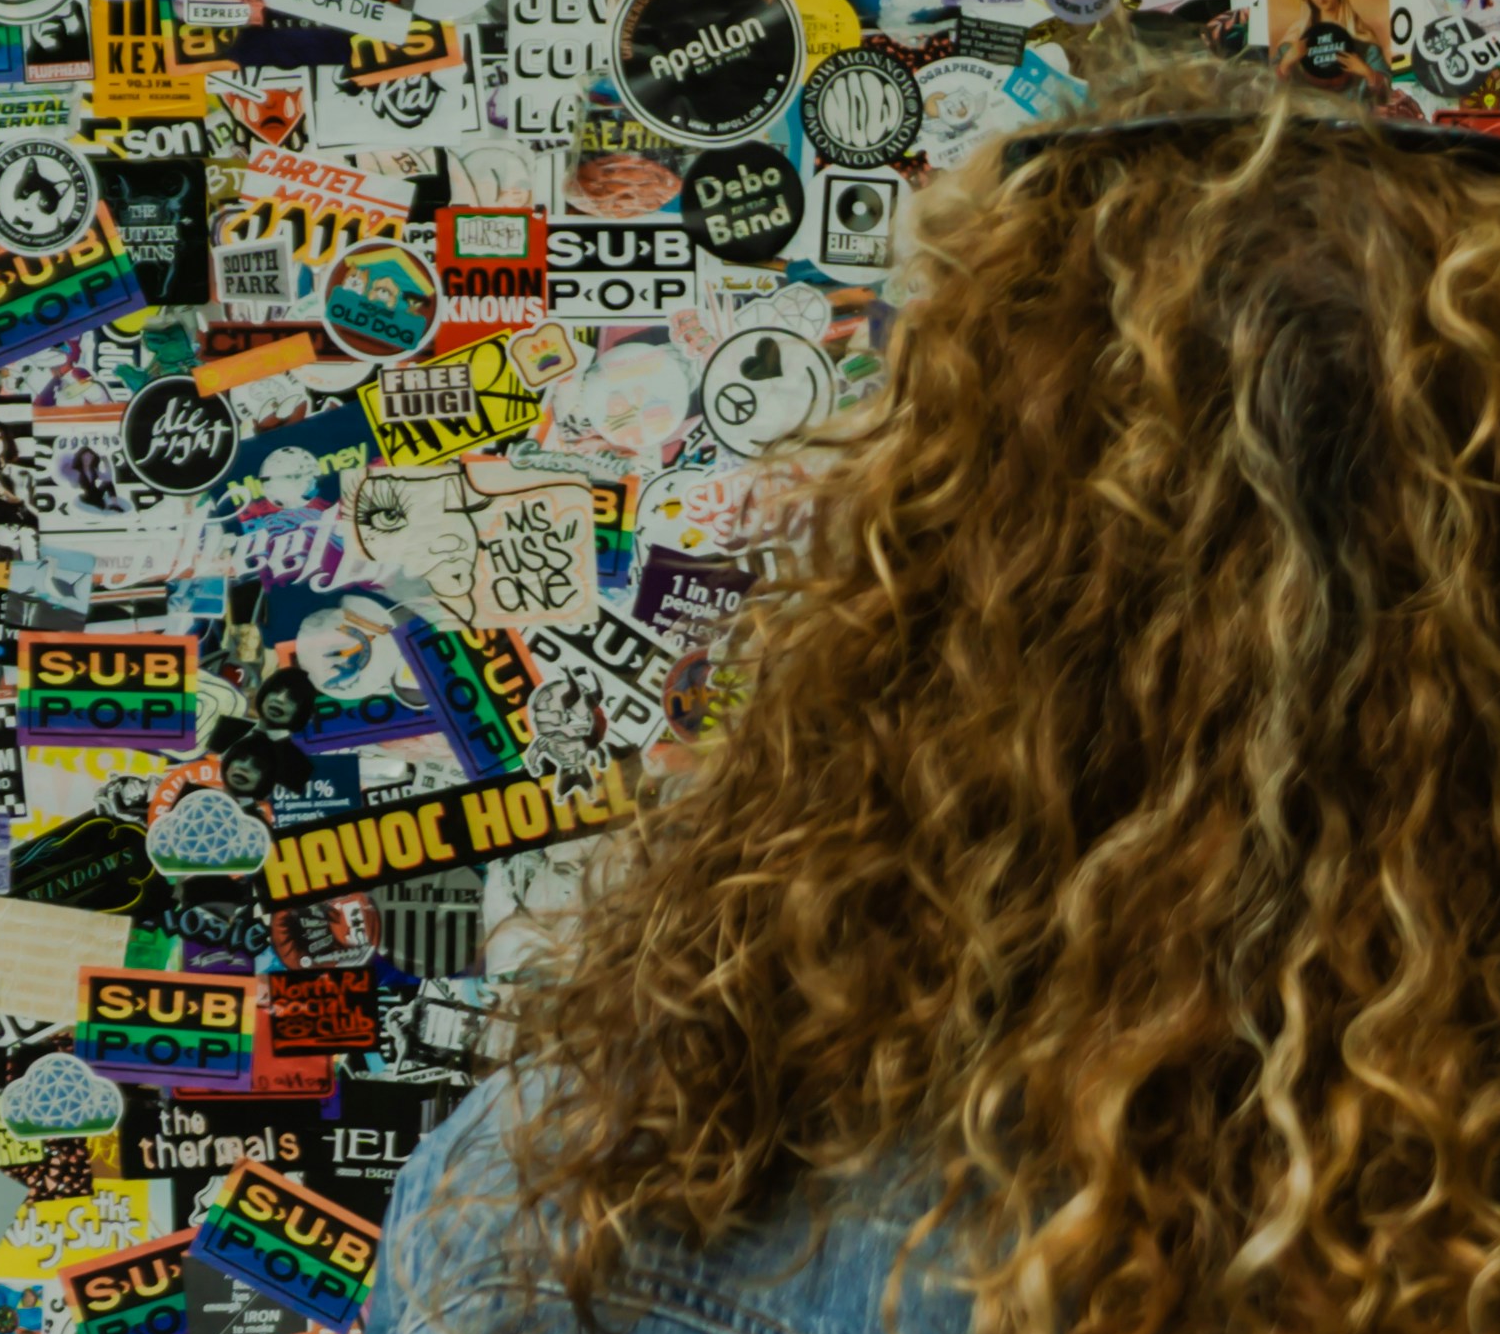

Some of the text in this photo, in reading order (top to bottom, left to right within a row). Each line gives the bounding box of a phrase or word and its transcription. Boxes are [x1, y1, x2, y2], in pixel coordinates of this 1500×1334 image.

[694, 164, 781, 206] Debo
[708, 203, 791, 245] Band
[225, 250, 279, 274] SOUTH
[227, 274, 279, 296] PARK
[444, 268, 542, 297] GOON
[443, 297, 545, 324] KNOWS
[264, 800, 453, 900] HAVOC
